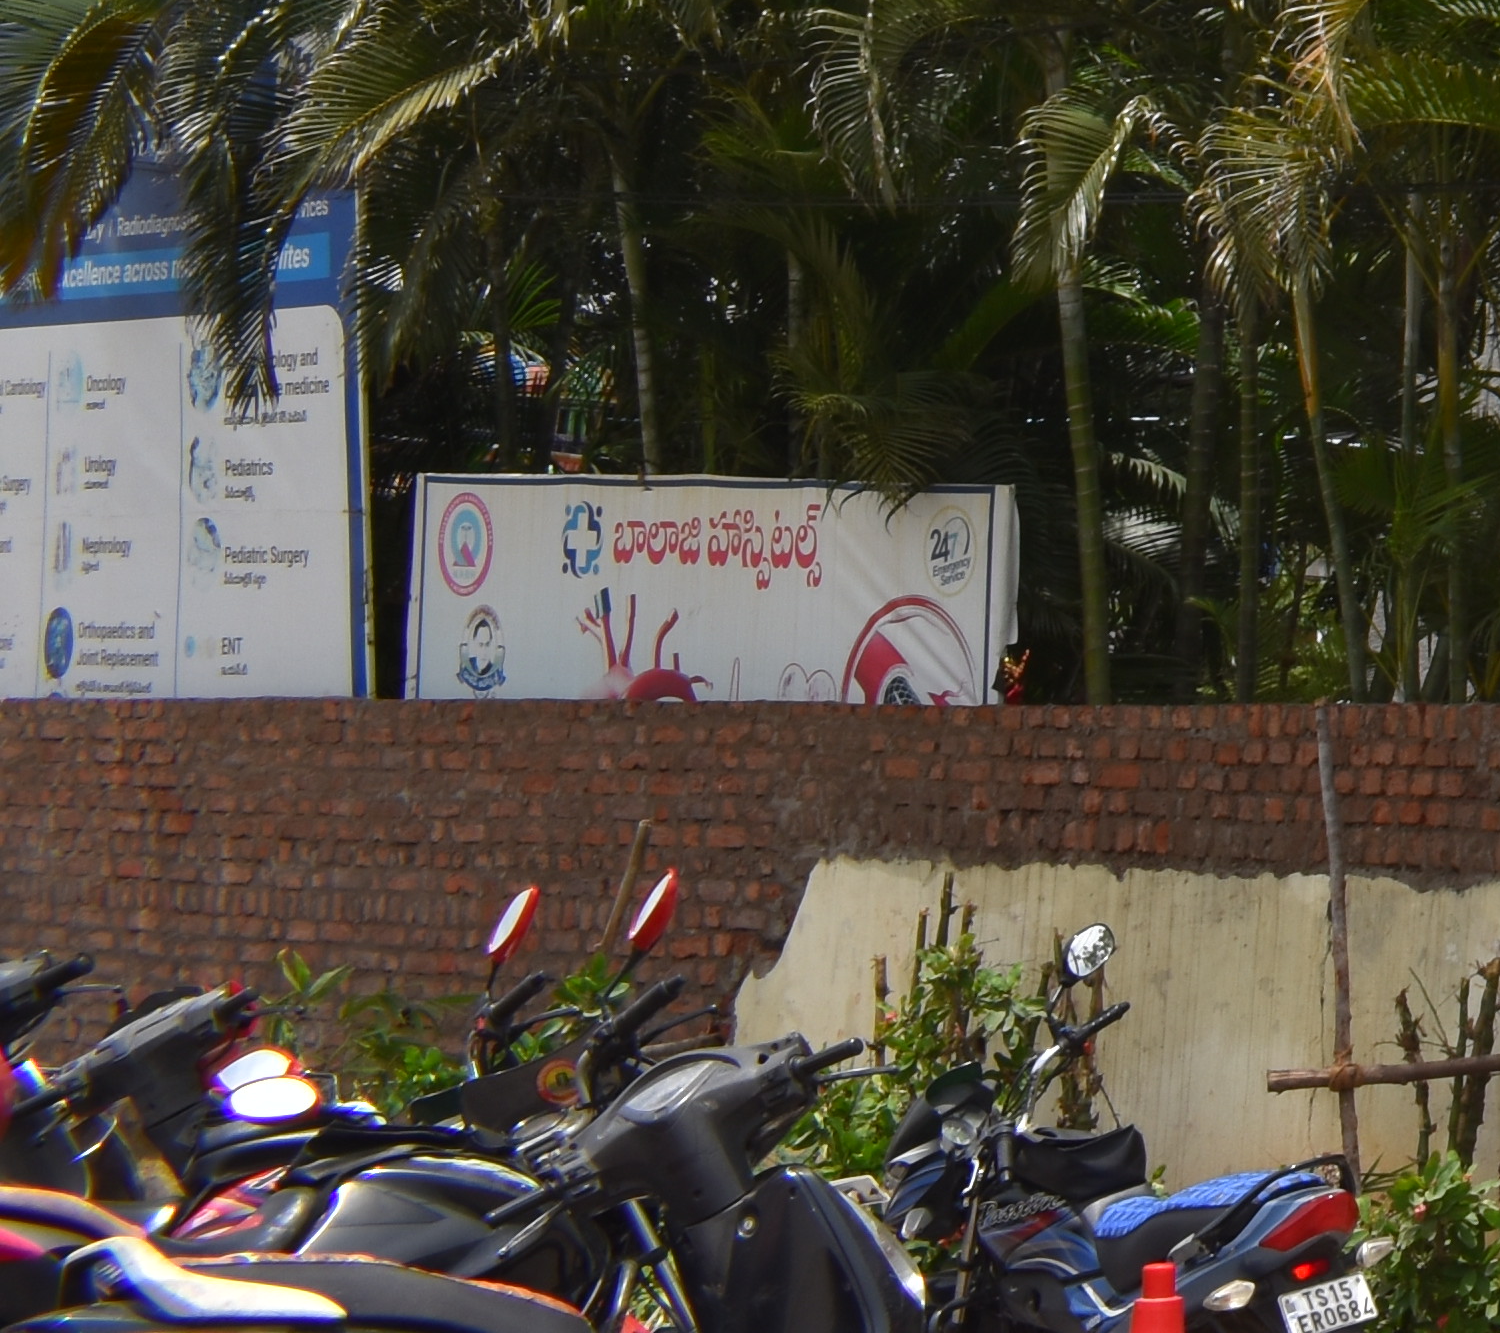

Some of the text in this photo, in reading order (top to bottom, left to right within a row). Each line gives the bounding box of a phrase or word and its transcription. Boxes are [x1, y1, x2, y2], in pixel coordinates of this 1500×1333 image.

[63, 259, 121, 288] xcellence
[124, 259, 168, 282] across
[300, 347, 319, 366] and
[87, 374, 126, 395] Oncology
[285, 375, 330, 396] medicine
[85, 455, 117, 477] Urology
[225, 458, 274, 477] Pediatrics
[82, 536, 132, 558] Nephrology
[613, 516, 701, 565] బాలాజి
[225, 545, 310, 568] Pediatric Surgery
[933, 556, 972, 577] Emergency
[940, 570, 966, 586] Service
[78, 622, 155, 642] Orthopaedics and
[221, 637, 243, 655] ENT
[77, 649, 159, 669] Joint Replacement
[1302, 1280, 1353, 1311] TS15
